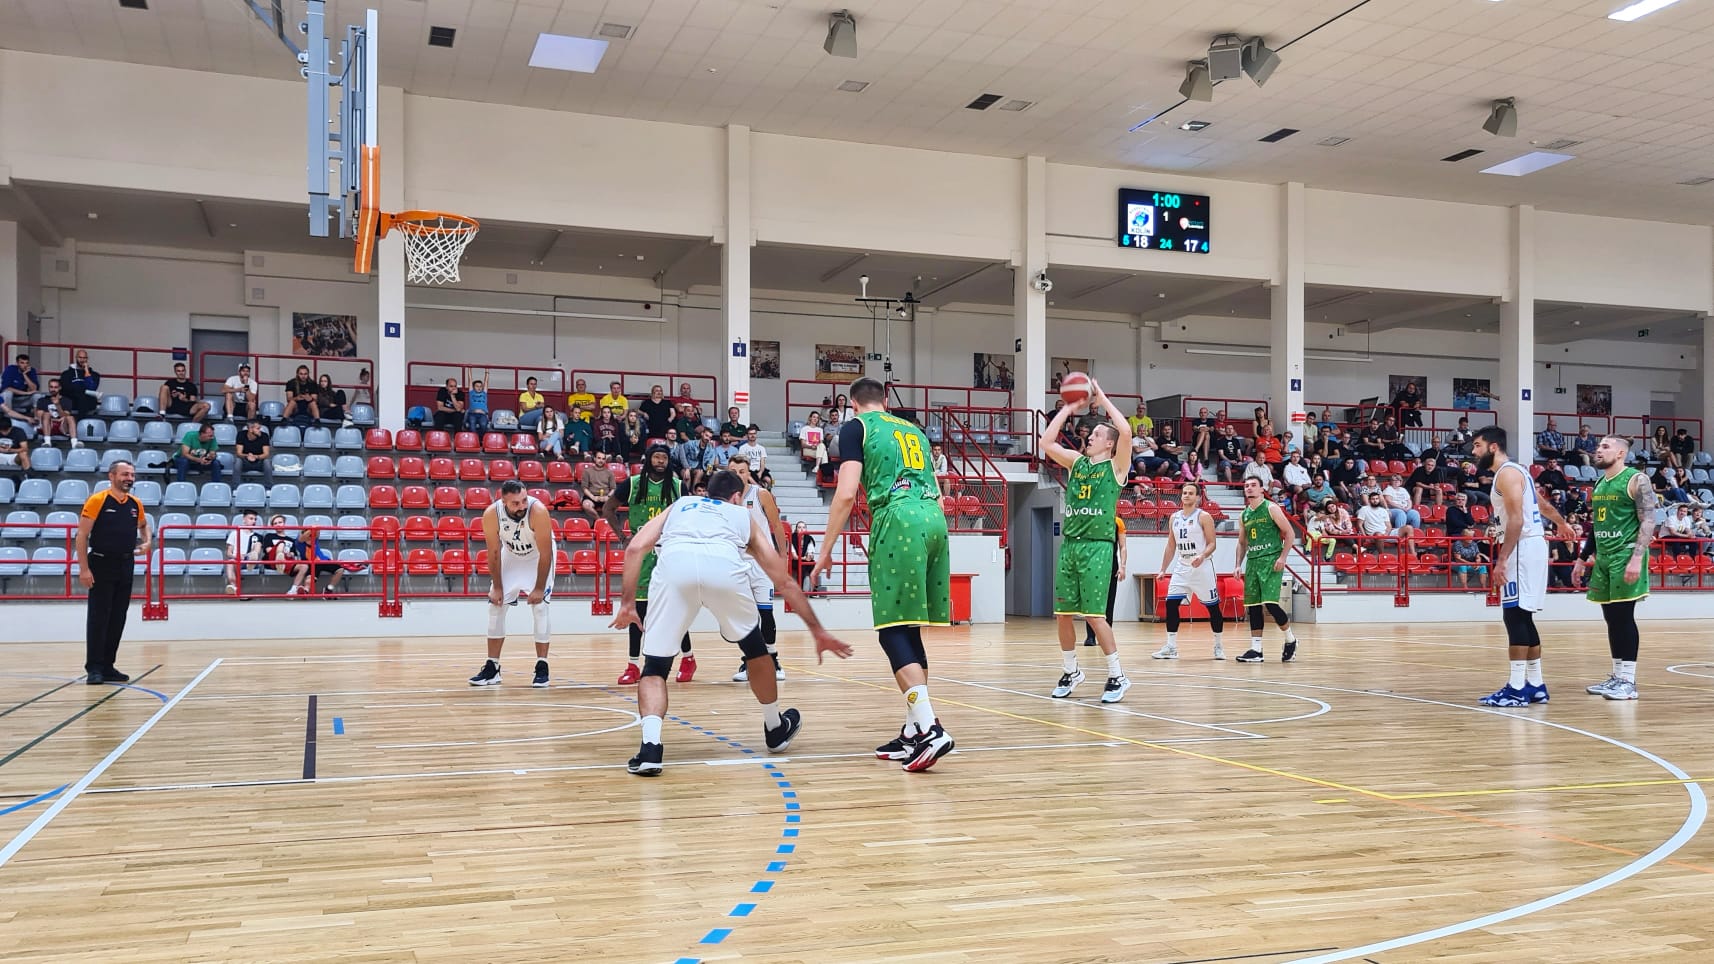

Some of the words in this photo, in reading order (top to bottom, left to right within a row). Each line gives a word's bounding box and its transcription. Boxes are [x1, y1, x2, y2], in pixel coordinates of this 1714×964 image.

[1153, 193, 1180, 208] 1:00
[1163, 211, 1169, 222] 1
[1134, 235, 1149, 248] 18
[1160, 238, 1172, 249] 24
[1184, 239, 1198, 252] 17
[1201, 241, 1208, 252] 4
[893, 430, 925, 470] 18
[1078, 484, 1092, 499] 31
[1597, 507, 1607, 521] 13
[1180, 529, 1188, 539] 12
[1251, 528, 1257, 539] 8
[1210, 588, 1218, 599] 12
[1503, 581, 1518, 598] 10
